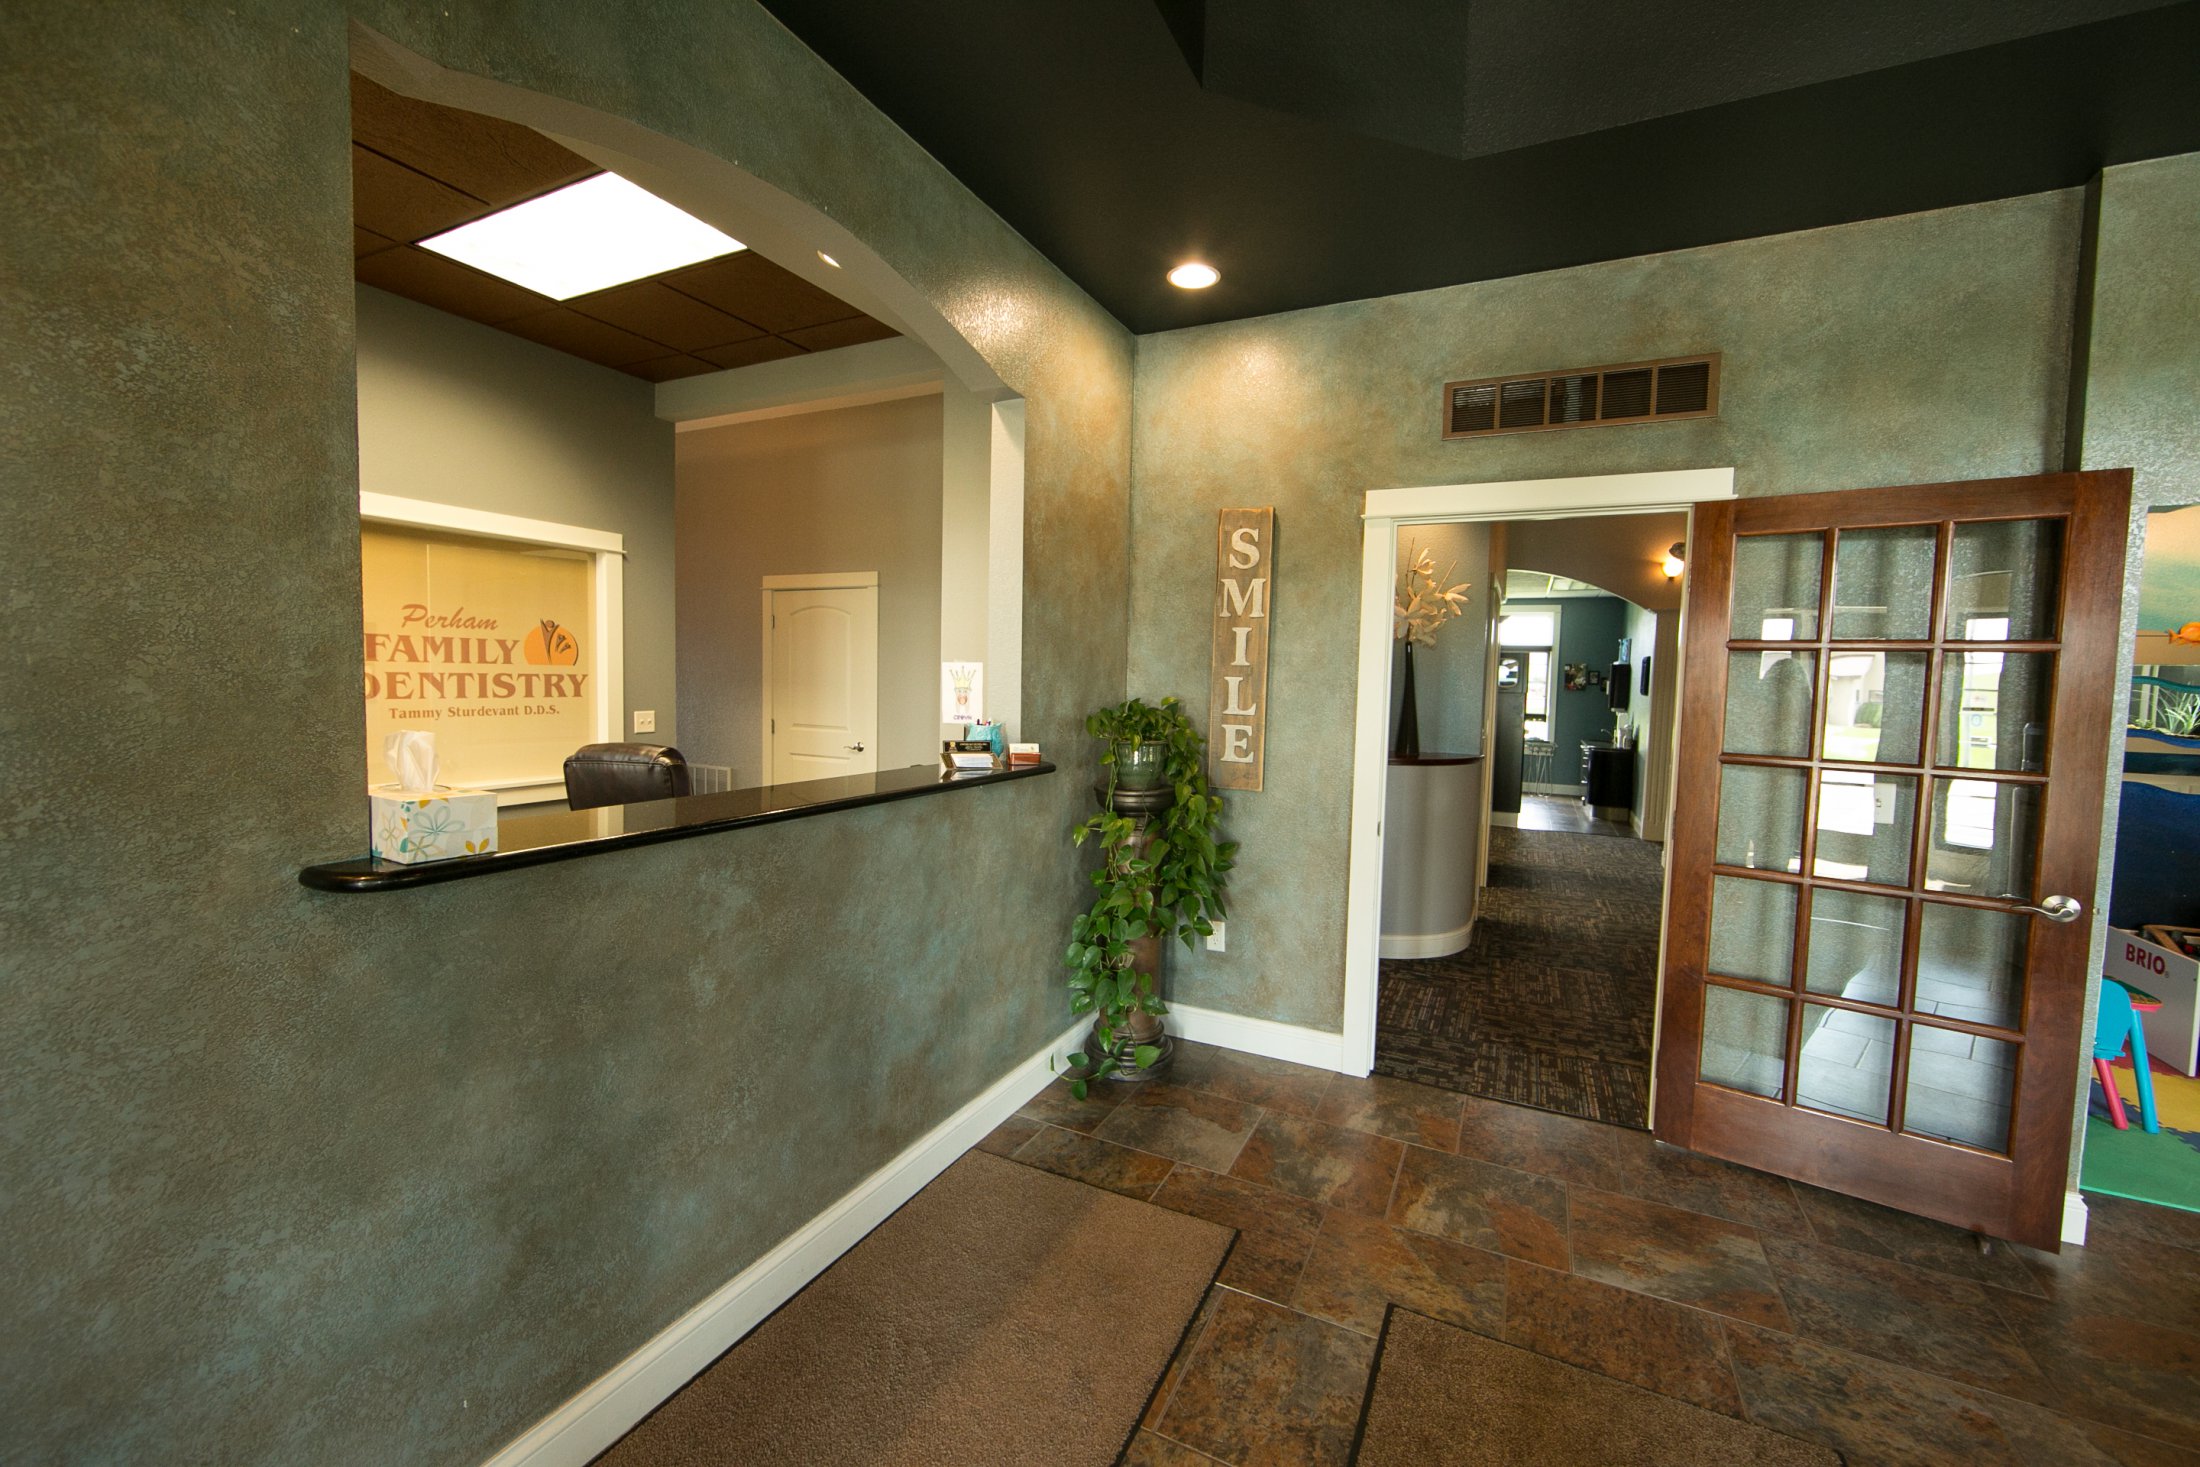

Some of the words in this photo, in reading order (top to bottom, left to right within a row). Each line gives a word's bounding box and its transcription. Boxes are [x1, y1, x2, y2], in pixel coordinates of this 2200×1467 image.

[401, 604, 498, 630] Perham
[364, 633, 520, 665] FAMILY
[1219, 527, 1267, 763] SMILE
[389, 708, 442, 720] Tammy
[448, 705, 519, 718] Sturdevant
[524, 704, 560, 716] D.D.S.
[2125, 942, 2165, 975] BRIO
